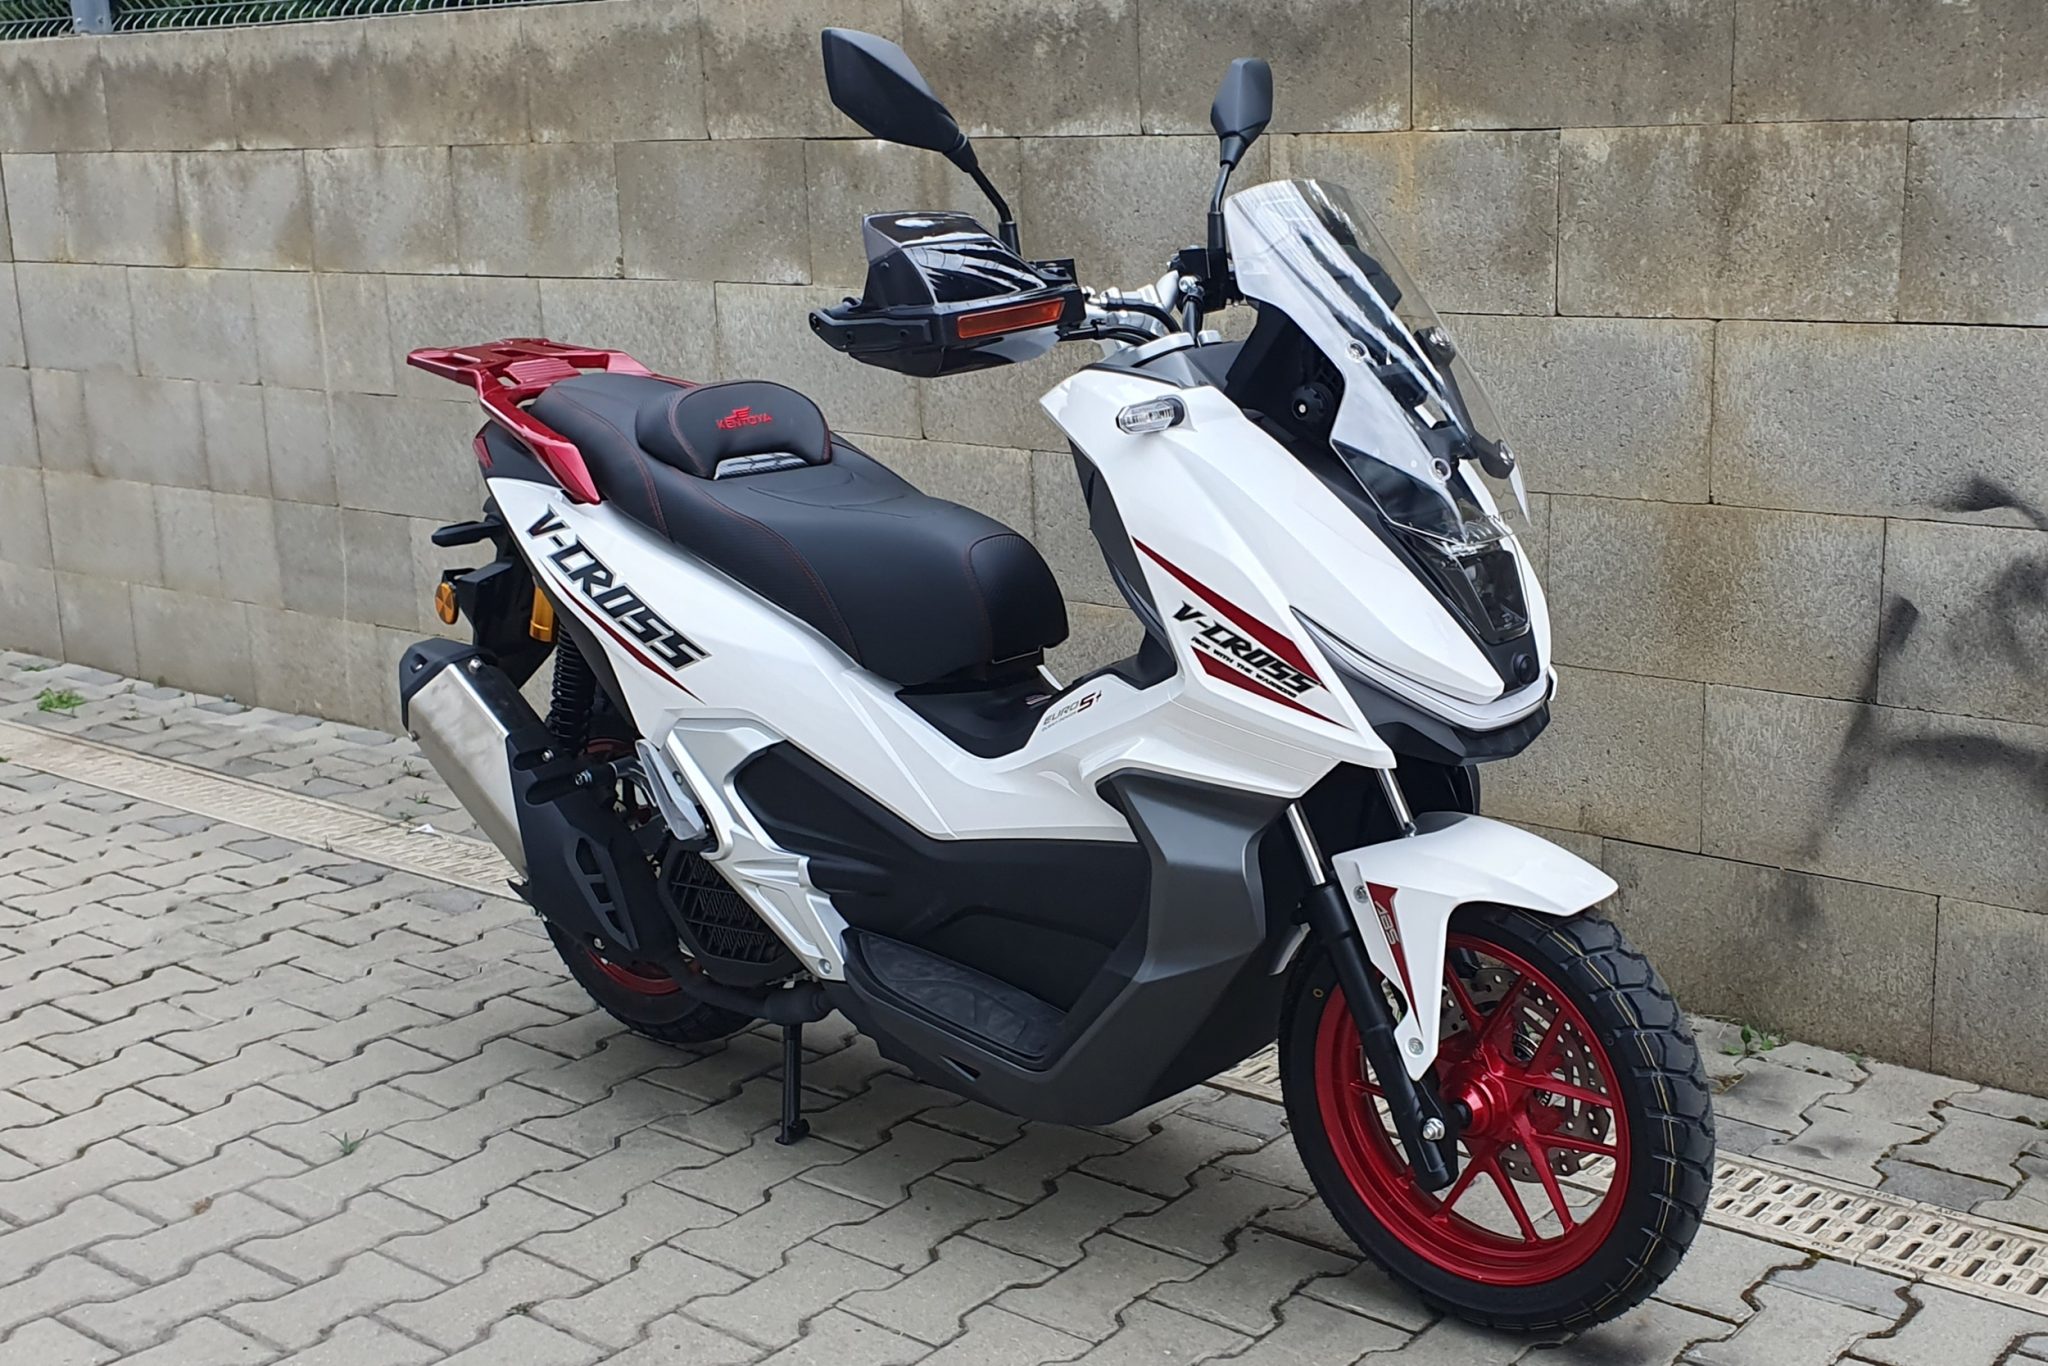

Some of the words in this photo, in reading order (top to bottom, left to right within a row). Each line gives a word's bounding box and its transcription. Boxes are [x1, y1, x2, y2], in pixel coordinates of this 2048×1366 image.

[526, 504, 712, 671] V-CROSS
[1173, 600, 1322, 694] V-CROSS
[1374, 900, 1400, 945] ABS
